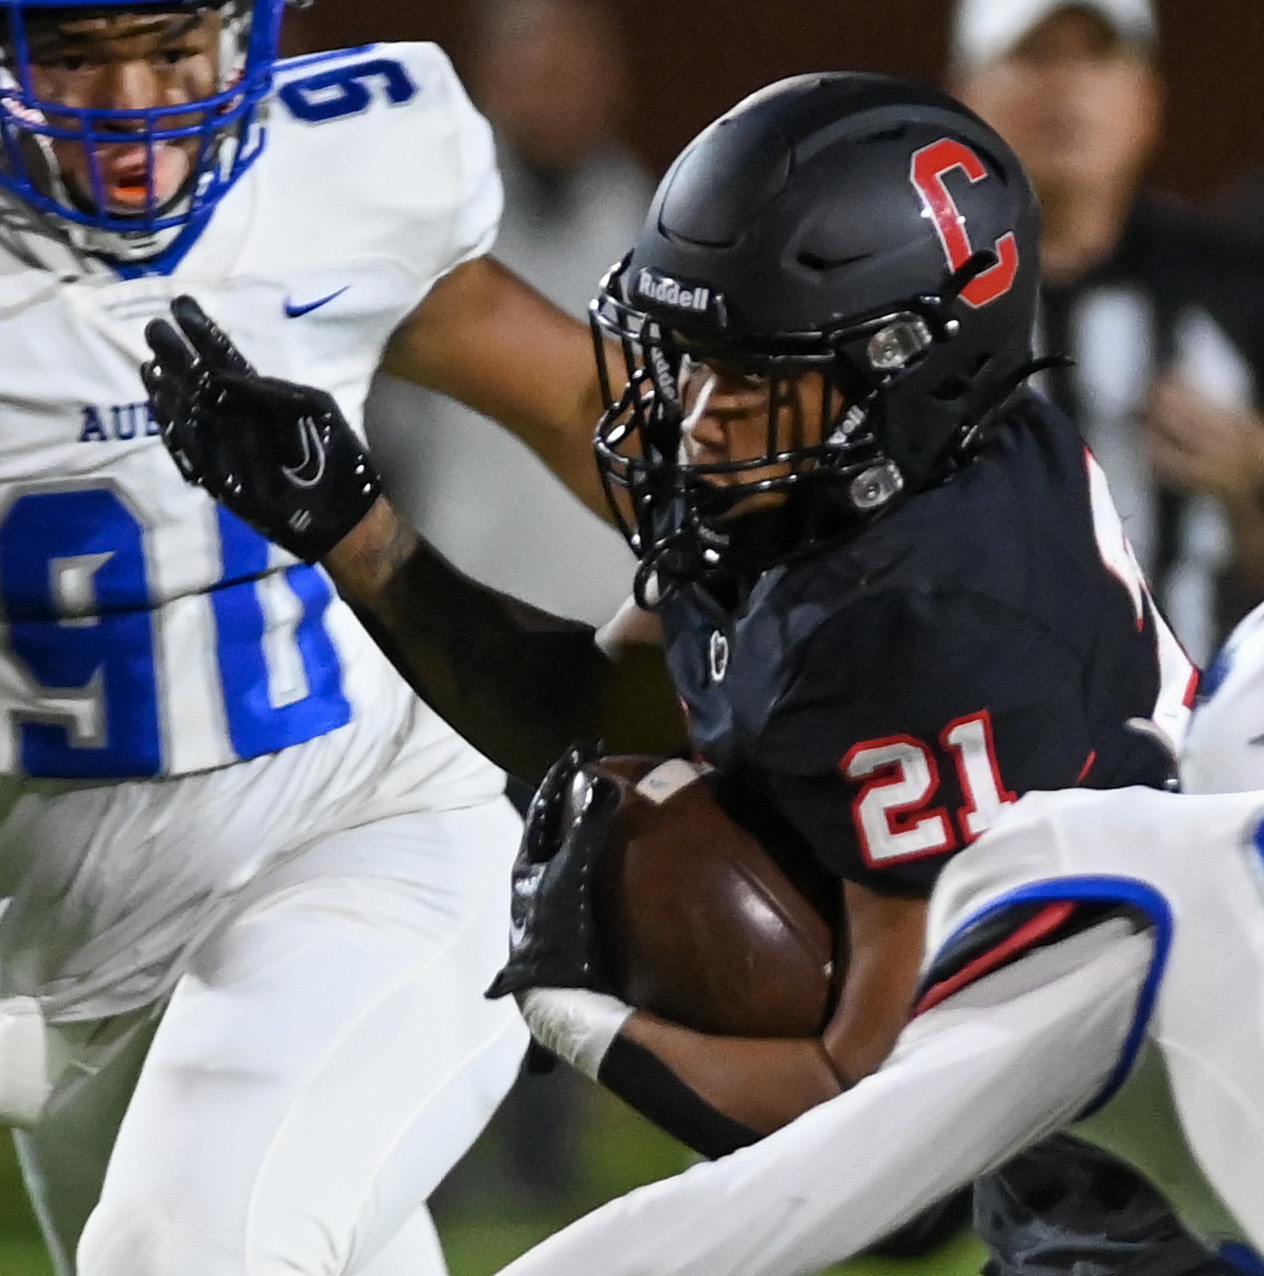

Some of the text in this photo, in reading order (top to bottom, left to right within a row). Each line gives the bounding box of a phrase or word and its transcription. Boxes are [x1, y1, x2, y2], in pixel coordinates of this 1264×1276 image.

[638, 270, 710, 310] Riddell
[910, 137, 1019, 310] C
[0, 478, 353, 780] 90
[840, 708, 1019, 868] 21
